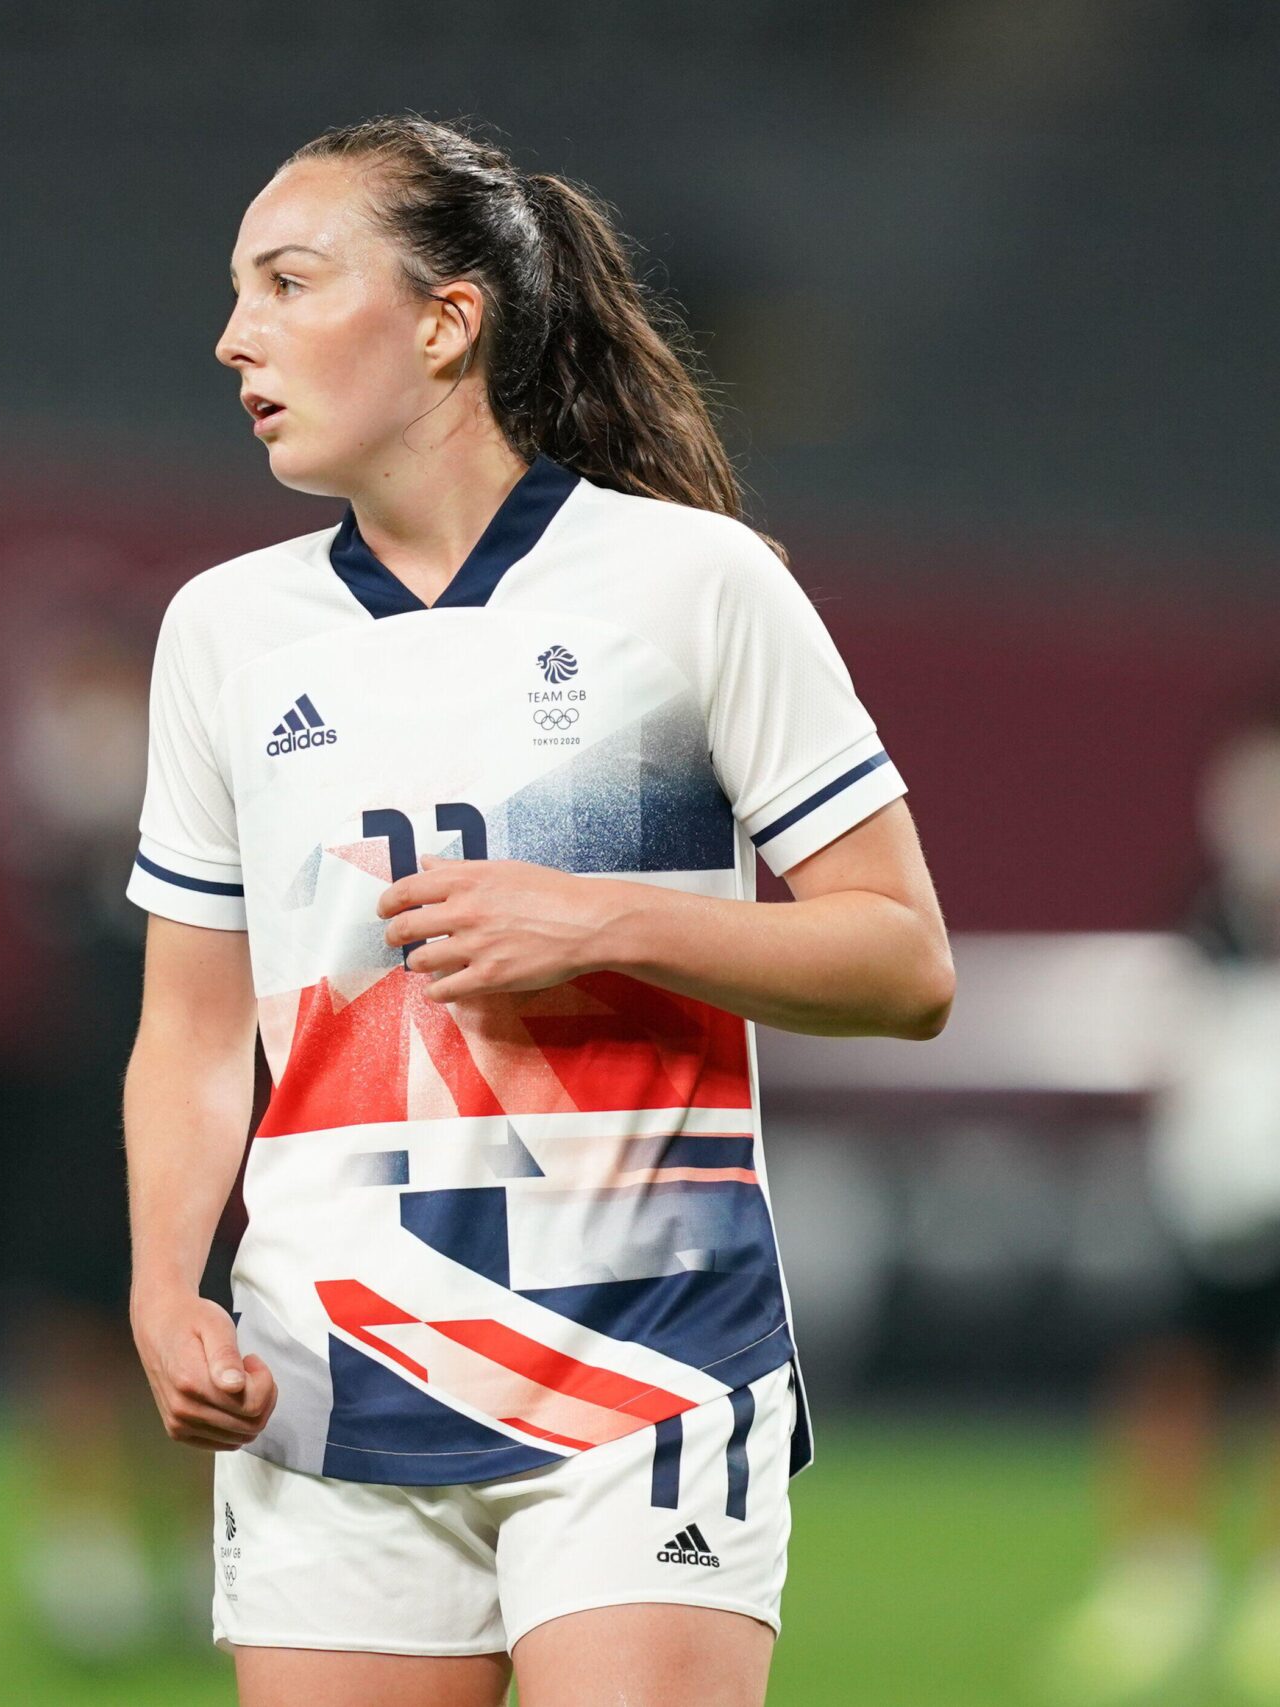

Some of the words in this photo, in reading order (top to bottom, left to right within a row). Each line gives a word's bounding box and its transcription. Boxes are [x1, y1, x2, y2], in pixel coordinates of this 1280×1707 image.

[528, 690, 563, 703] TEAM
[567, 689, 587, 701] GB
[266, 729, 338, 757] adidas
[533, 738, 559, 746] TOKYO
[560, 737, 580, 745] 2020
[656, 1549, 720, 1568] adidas
